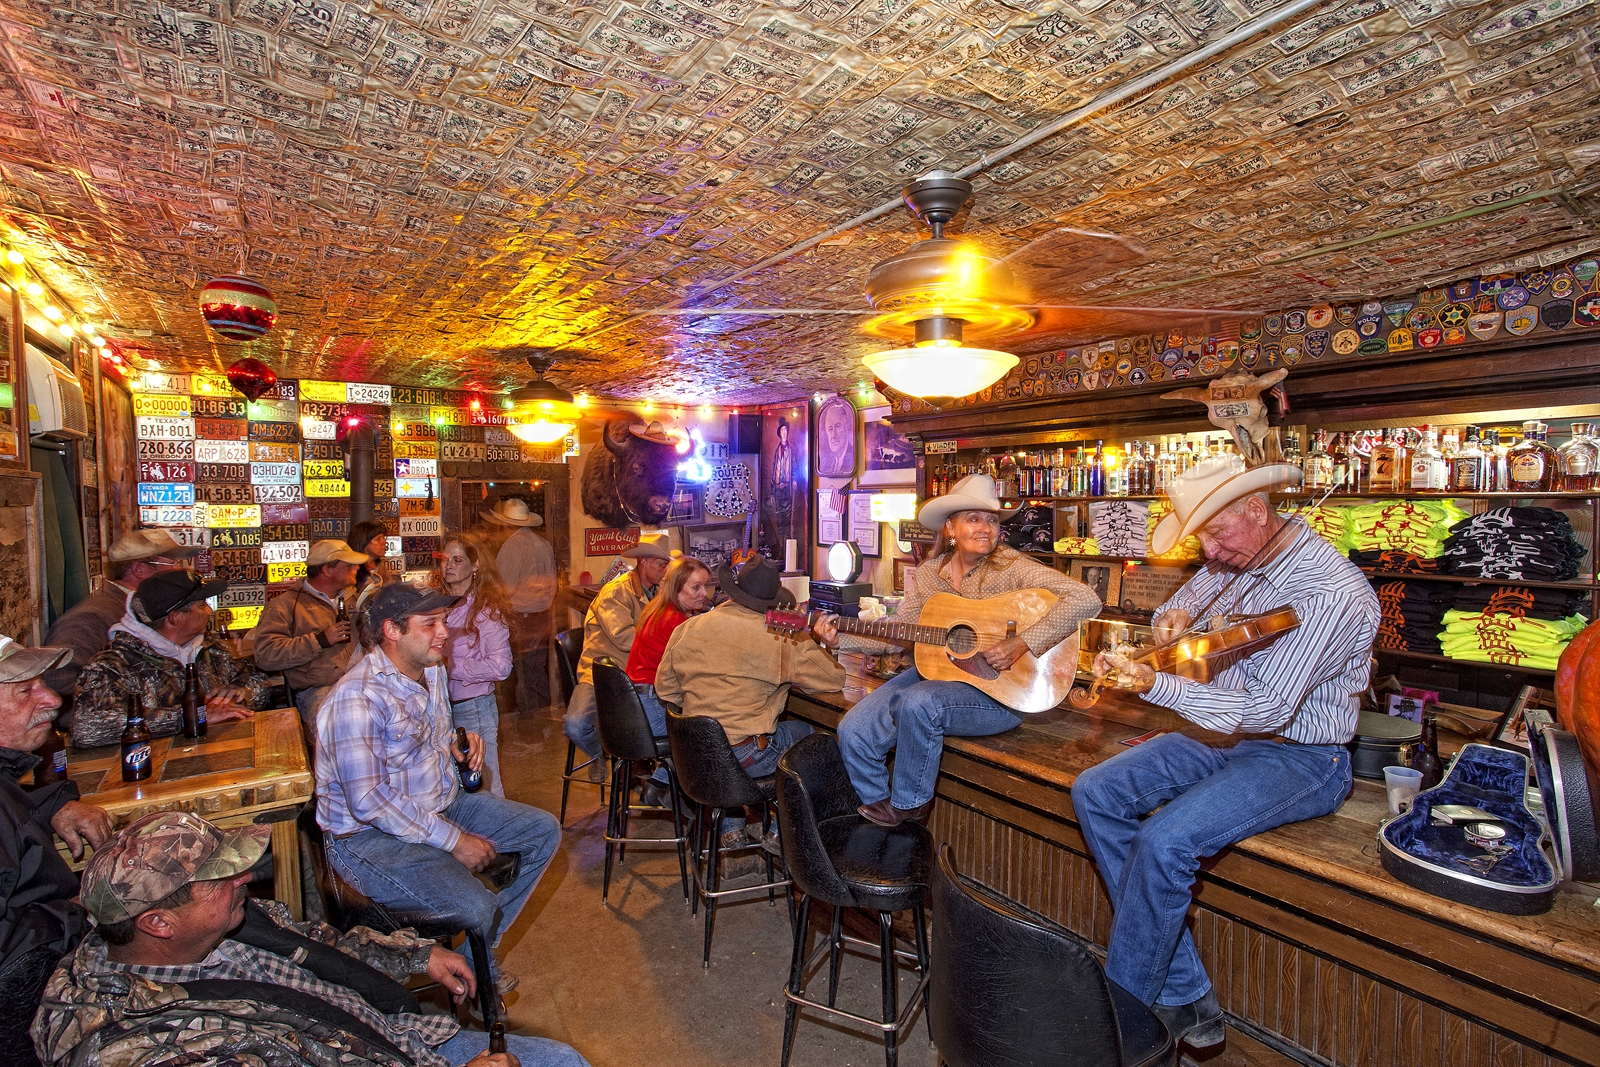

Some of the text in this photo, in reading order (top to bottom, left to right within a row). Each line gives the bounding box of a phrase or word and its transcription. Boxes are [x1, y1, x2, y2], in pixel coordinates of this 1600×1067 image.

[1508, 306, 1536, 317] POLICE
[1358, 316, 1380, 325] POLICE
[361, 388, 389, 400] 24249
[153, 400, 187, 411] 00000
[198, 448, 218, 459] ARP
[227, 448, 247, 460] 628
[313, 445, 343, 459] 4915
[543, 451, 557, 460] 289
[167, 466, 187, 478] 126
[304, 465, 344, 475] 762 903
[712, 469, 742, 478] ROUTE
[318, 484, 346, 493] 48444
[715, 489, 742, 511] 66
[162, 510, 192, 522] 2228
[589, 531, 636, 545] Yacht Club
[232, 591, 264, 602] 10392
